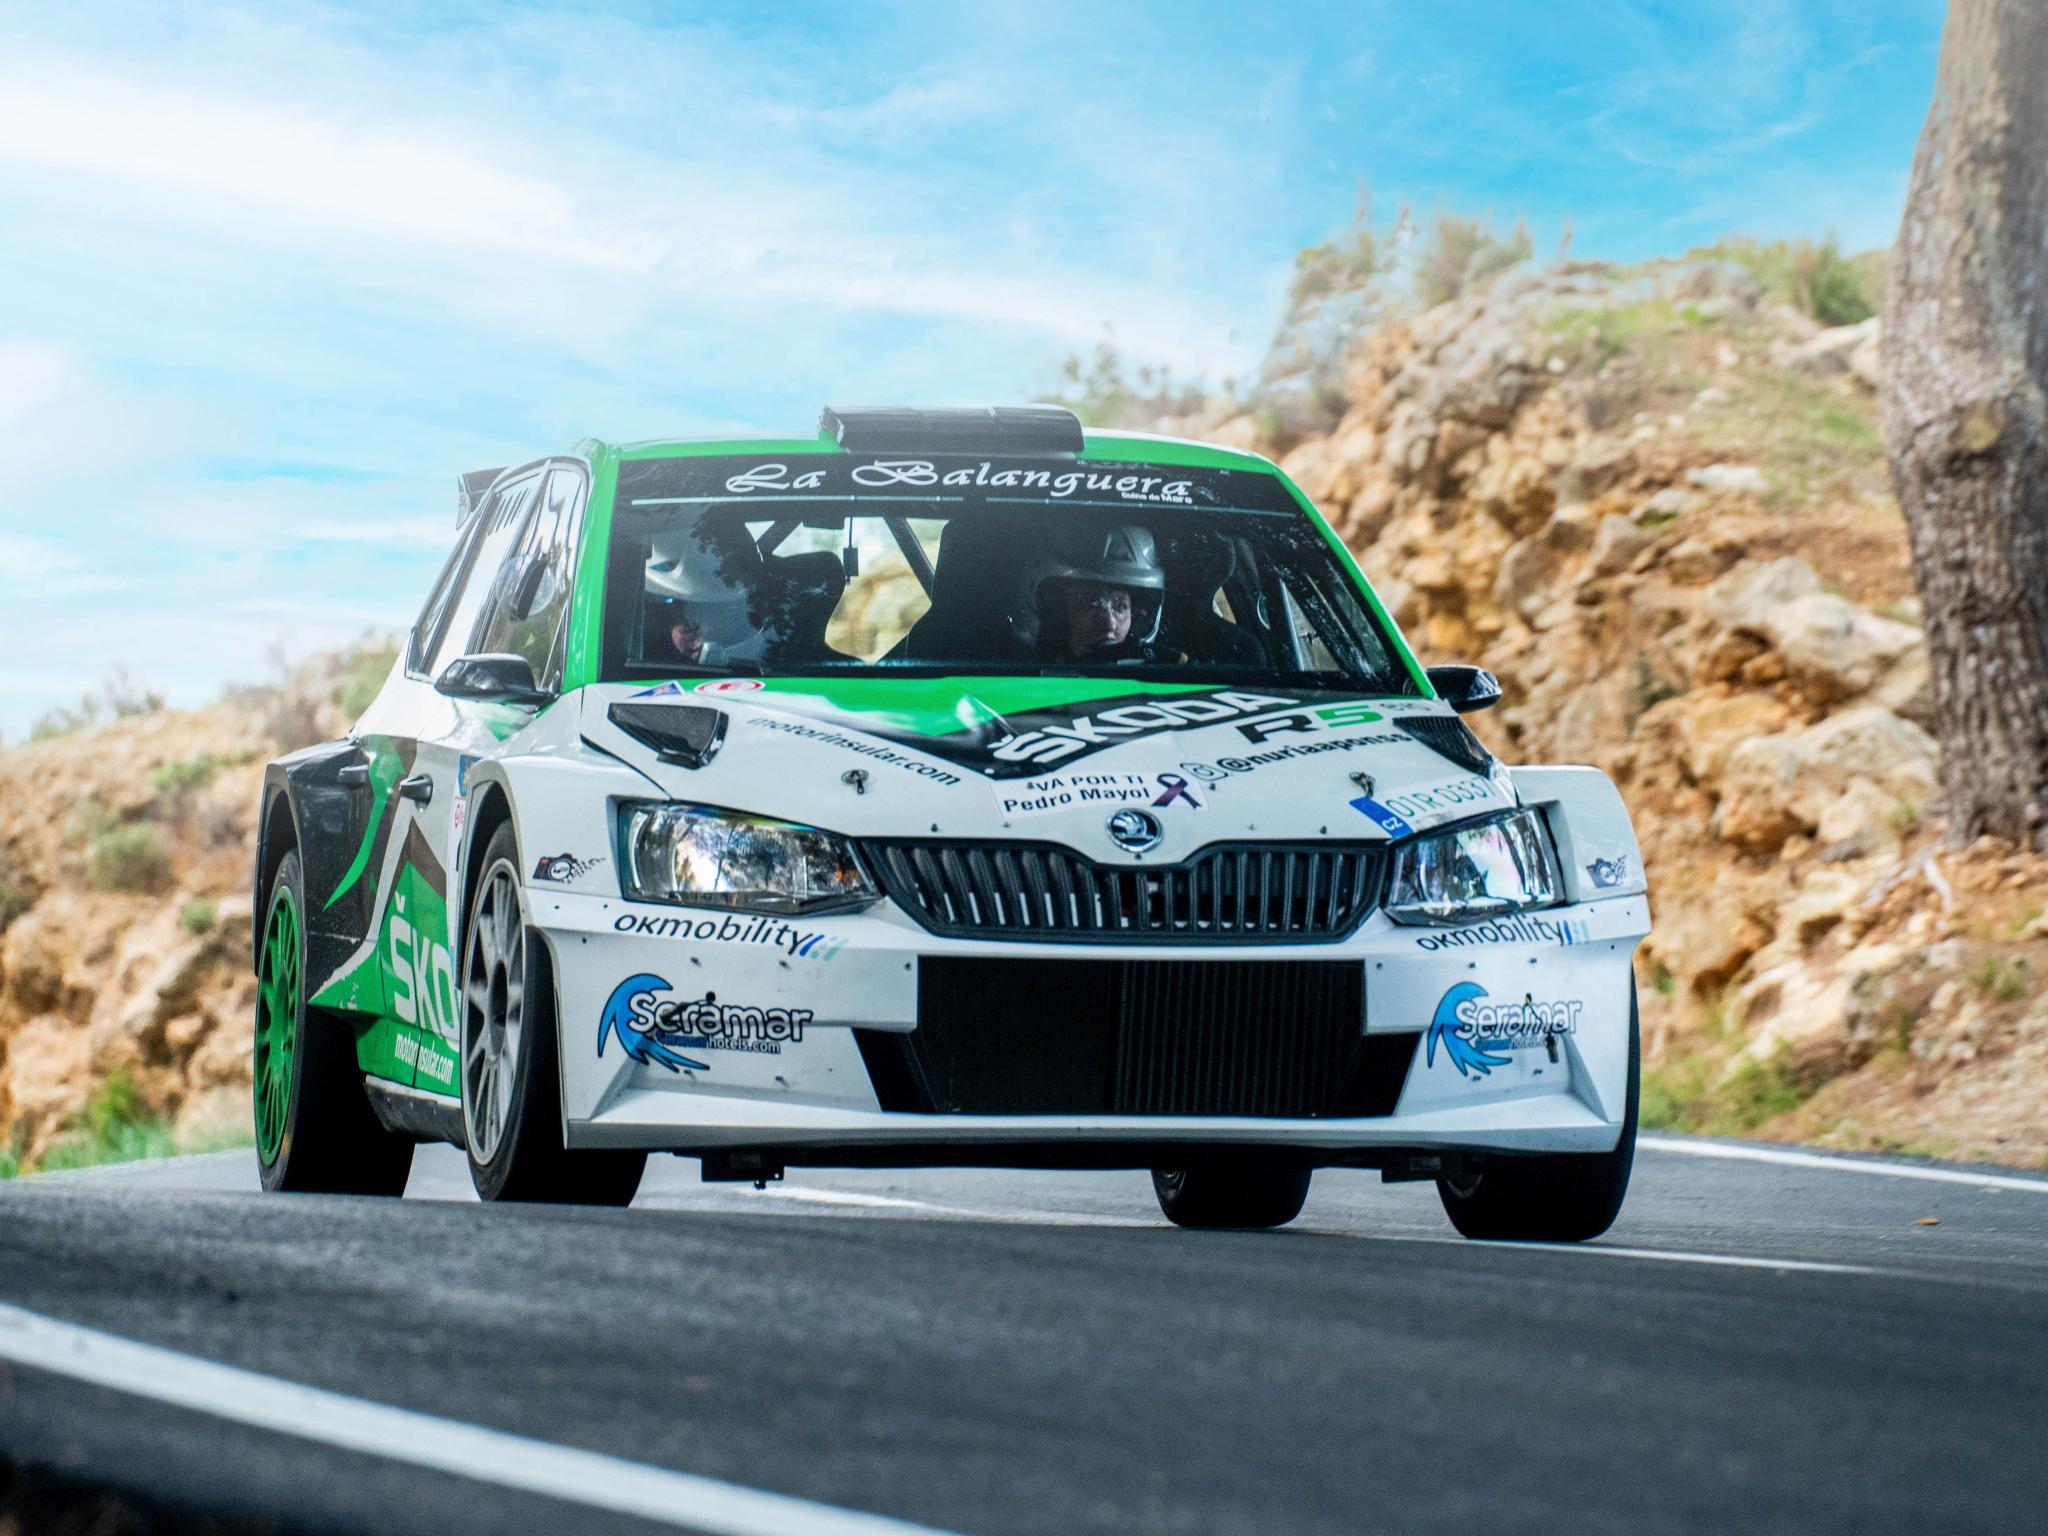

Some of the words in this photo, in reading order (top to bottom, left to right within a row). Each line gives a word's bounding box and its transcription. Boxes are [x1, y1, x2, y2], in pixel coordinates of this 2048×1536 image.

[725, 463, 826, 493] La
[852, 460, 1193, 497] Balanguera
[1235, 704, 1384, 744] R5
[747, 717, 961, 786] motorinsular.com
[1004, 792, 1072, 812] Pedro
[1079, 787, 1150, 801] Mayol
[1071, 775, 1116, 786] POR
[1125, 775, 1144, 784] TI
[1381, 817, 1403, 831] CZ
[614, 913, 813, 956] okmobility
[1416, 913, 1565, 951] okmobility
[390, 890, 460, 1053] ŠKO
[627, 991, 814, 1043] Seramar
[1455, 1000, 1582, 1040] Seramar
